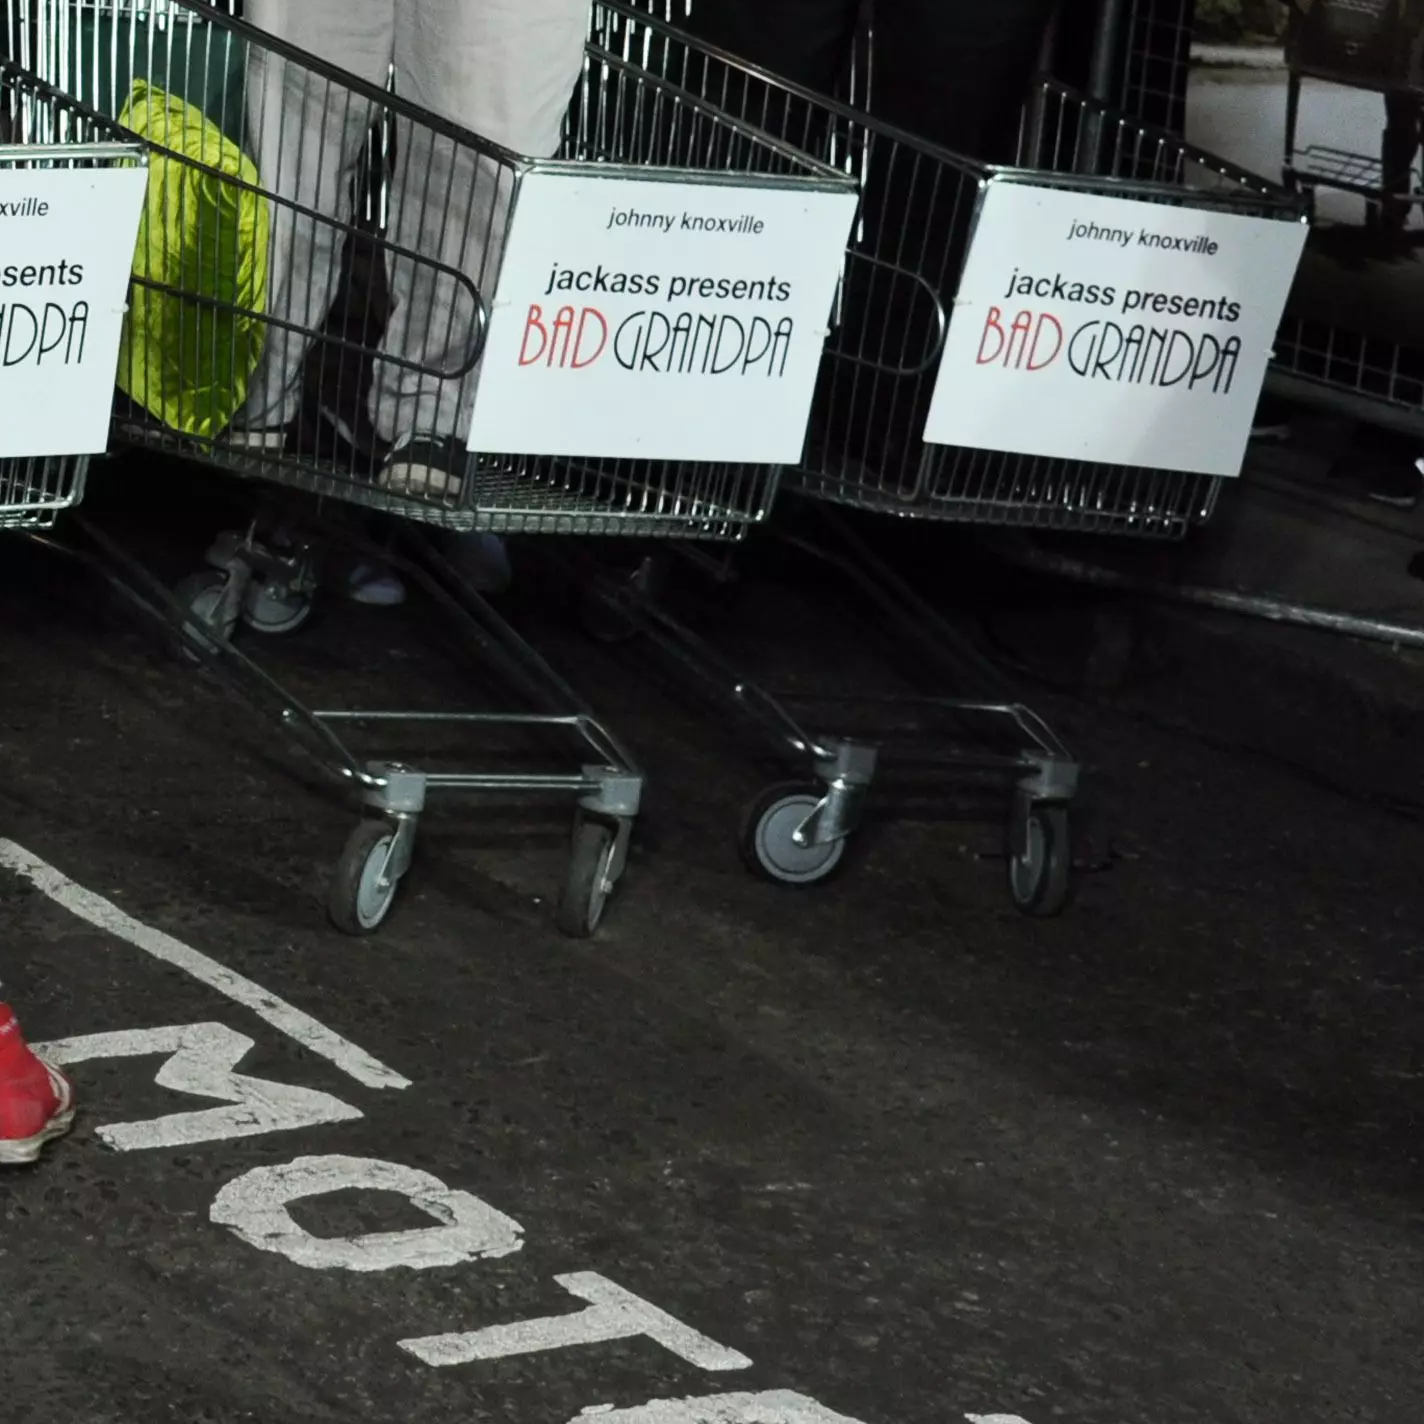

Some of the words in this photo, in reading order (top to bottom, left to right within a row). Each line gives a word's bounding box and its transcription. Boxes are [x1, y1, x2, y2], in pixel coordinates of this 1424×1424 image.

[607, 209, 675, 232] johnny
[681, 212, 764, 234] knoxville
[1067, 222, 1133, 247] johnny
[1138, 229, 1219, 256] knoxville
[544, 263, 660, 295] jackass
[667, 276, 791, 302] presents
[1004, 268, 1116, 306] jackass
[1121, 290, 1243, 323] presents
[519, 304, 607, 368] BAD
[614, 311, 793, 377] GRANDPA
[976, 307, 1062, 371] BAD
[1068, 320, 1242, 395] GRANDPA
